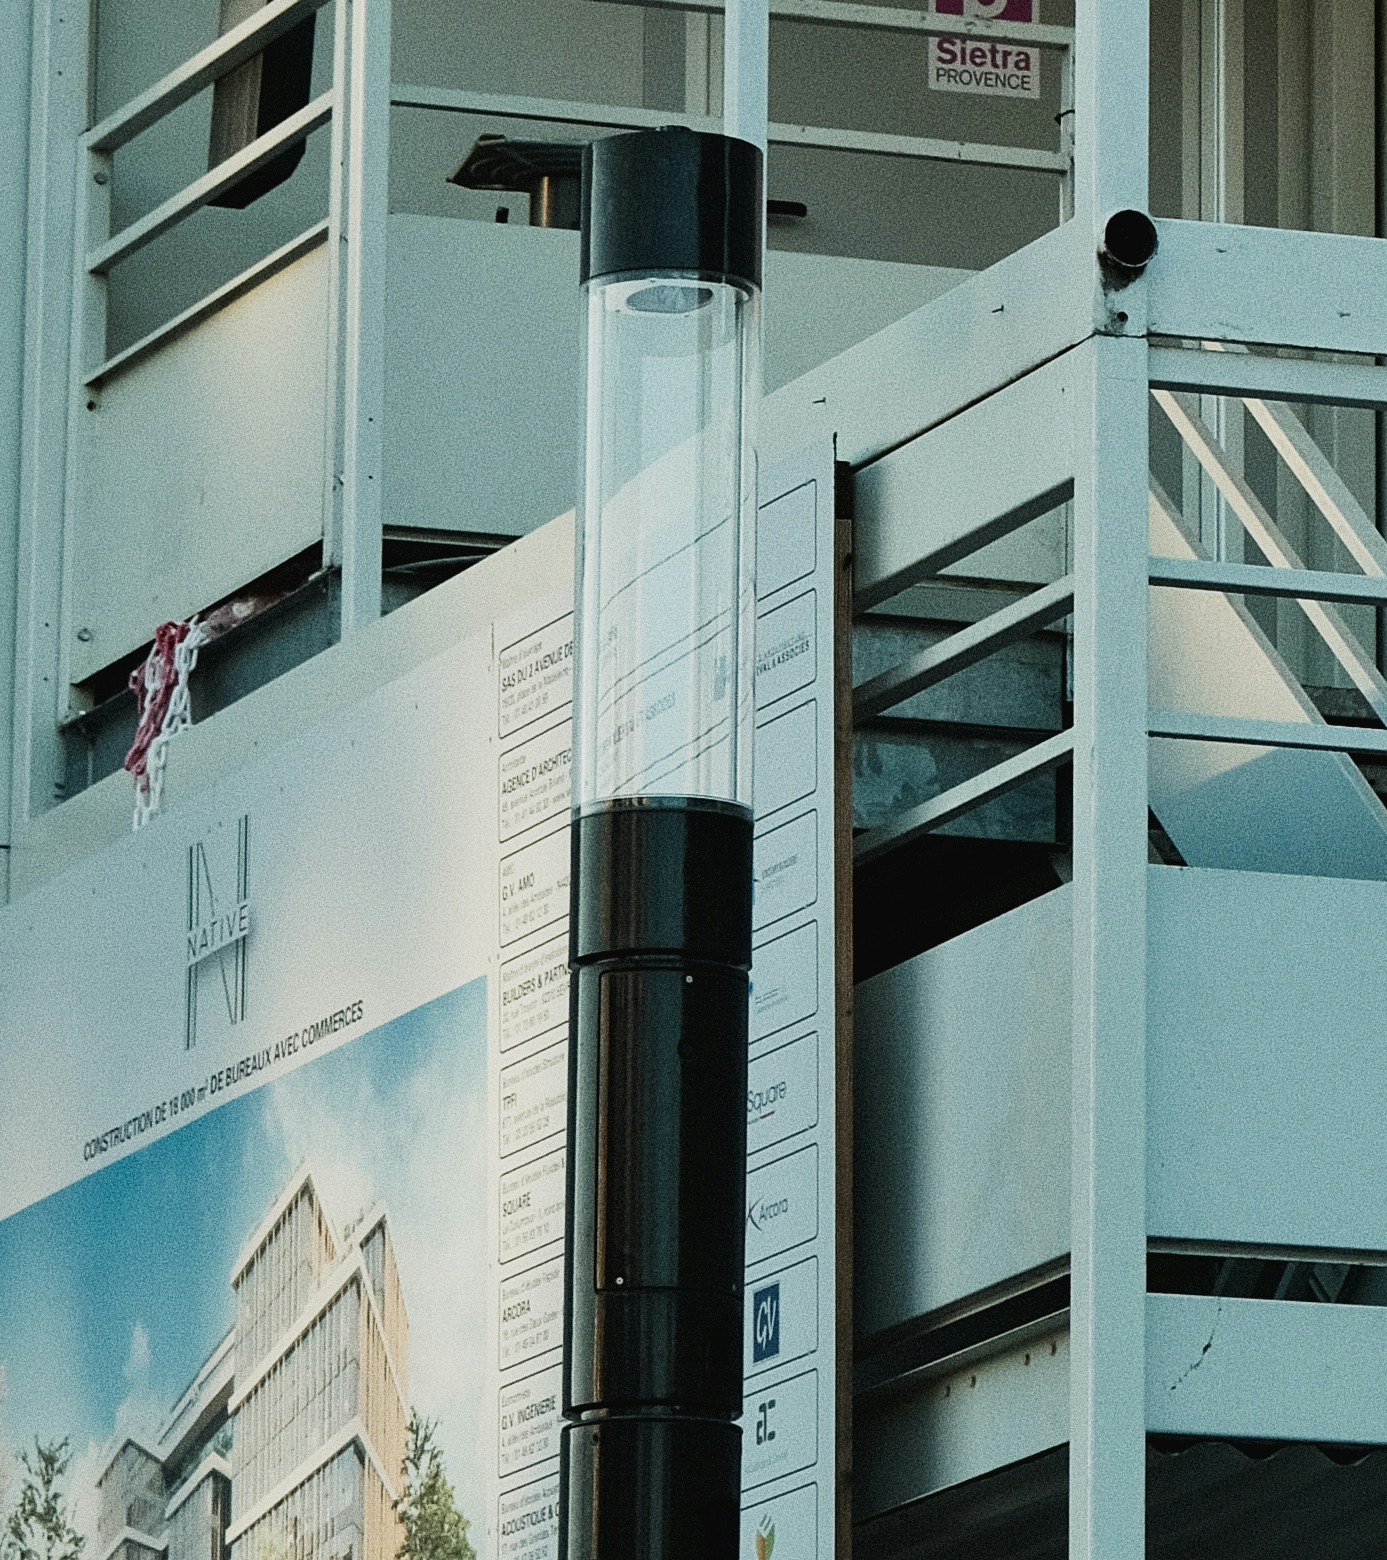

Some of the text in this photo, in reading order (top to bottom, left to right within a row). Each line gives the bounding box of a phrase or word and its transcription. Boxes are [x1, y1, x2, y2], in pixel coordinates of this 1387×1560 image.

[936, 36, 1031, 71] Sietra
[936, 67, 1031, 91] PROVENCE
[502, 673, 516, 692] SAS
[502, 769, 530, 794] AGENCE
[187, 904, 248, 957] NATIVE
[83, 1112, 154, 1161] CONSTRUCTION
[155, 1102, 167, 1123] DE
[210, 1074, 224, 1095] DE
[225, 1048, 271, 1087] BUREAUX
[274, 1032, 299, 1061] AVEC
[302, 999, 363, 1051] COMMERCES
[747, 1079, 786, 1113] Square
[758, 1197, 788, 1222] Arcora
